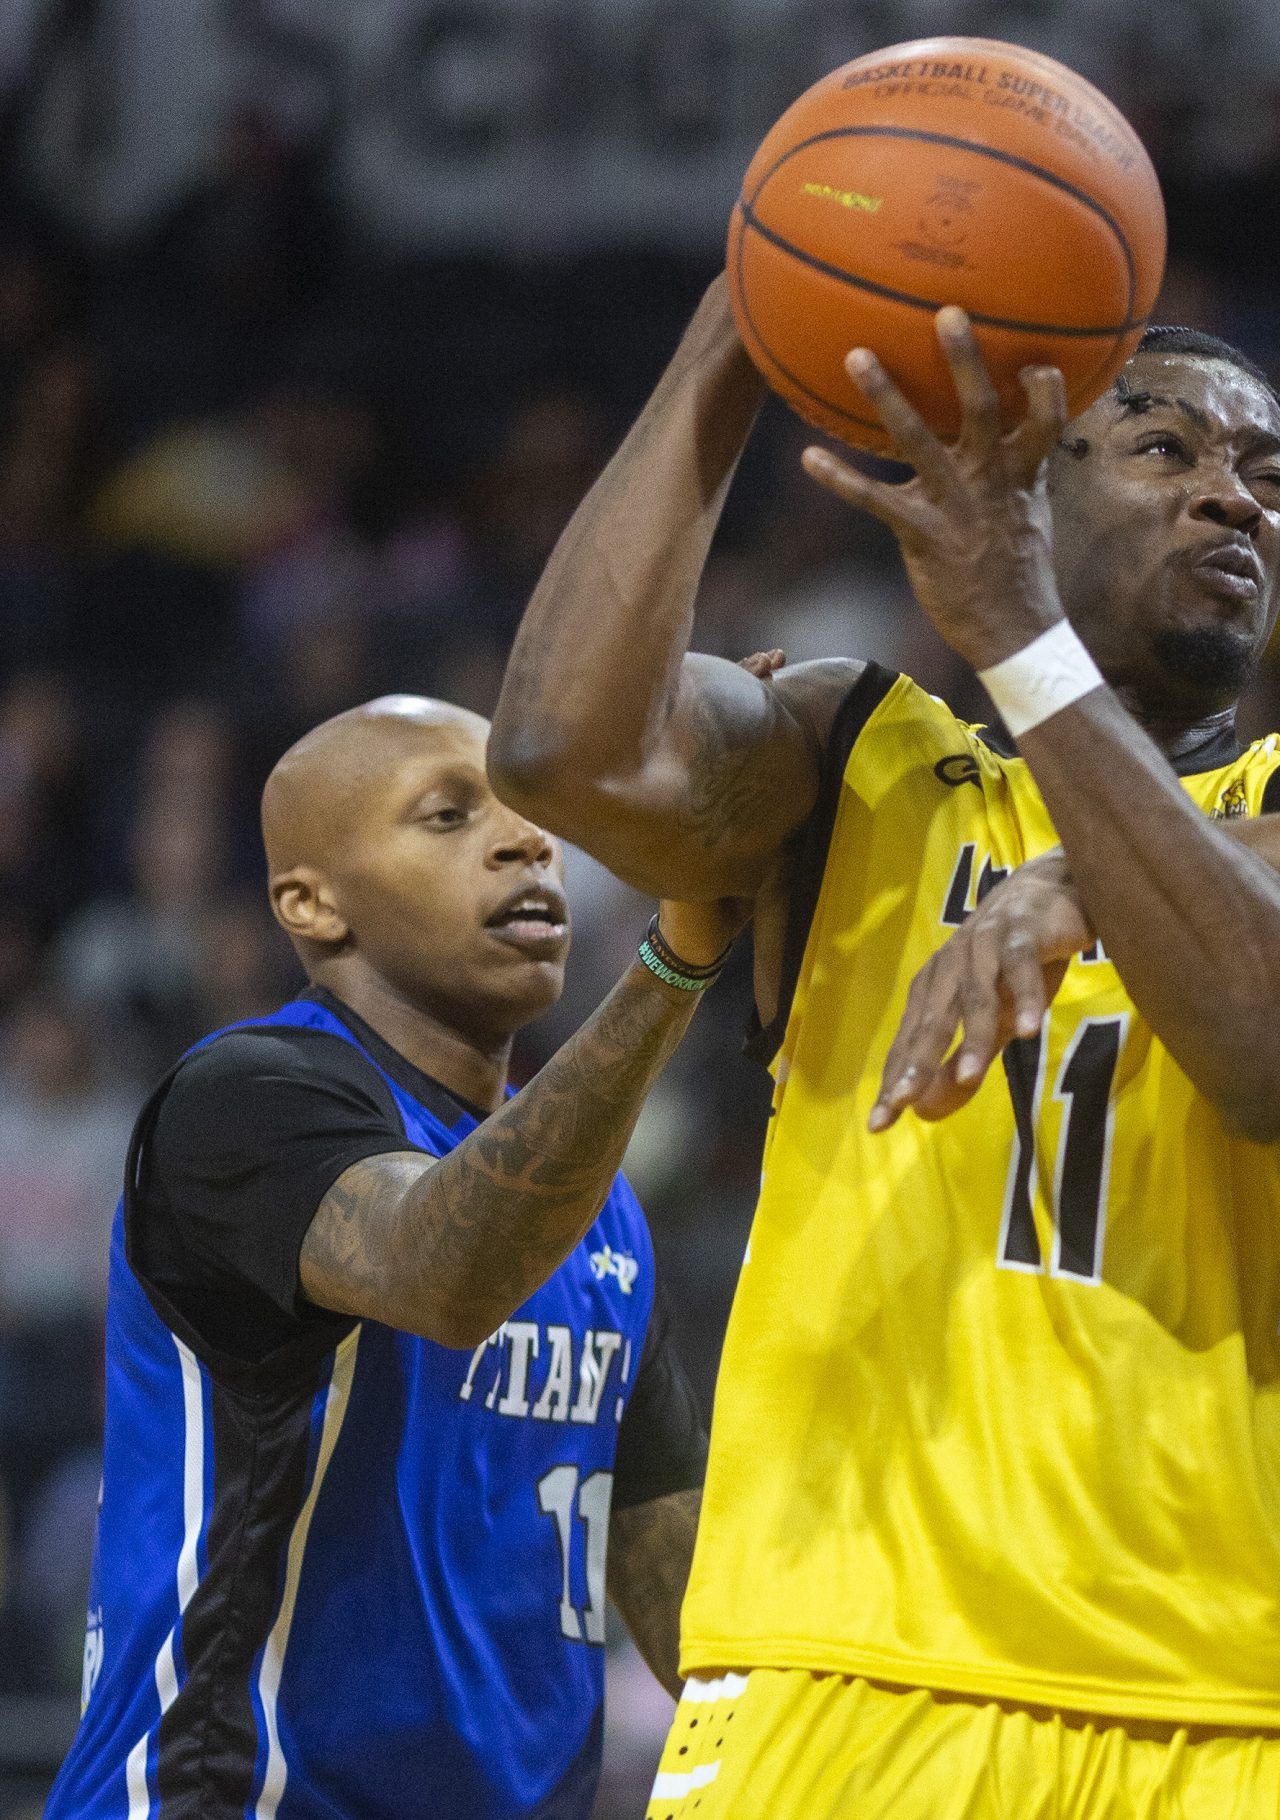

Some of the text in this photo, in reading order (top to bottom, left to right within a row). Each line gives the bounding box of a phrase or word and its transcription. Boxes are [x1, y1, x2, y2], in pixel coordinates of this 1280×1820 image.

[842, 62, 988, 91] BASKETBALL
[997, 71, 1071, 113] SUPER
[997, 1012, 1131, 1287] 11
[536, 1463, 615, 1645] 11
